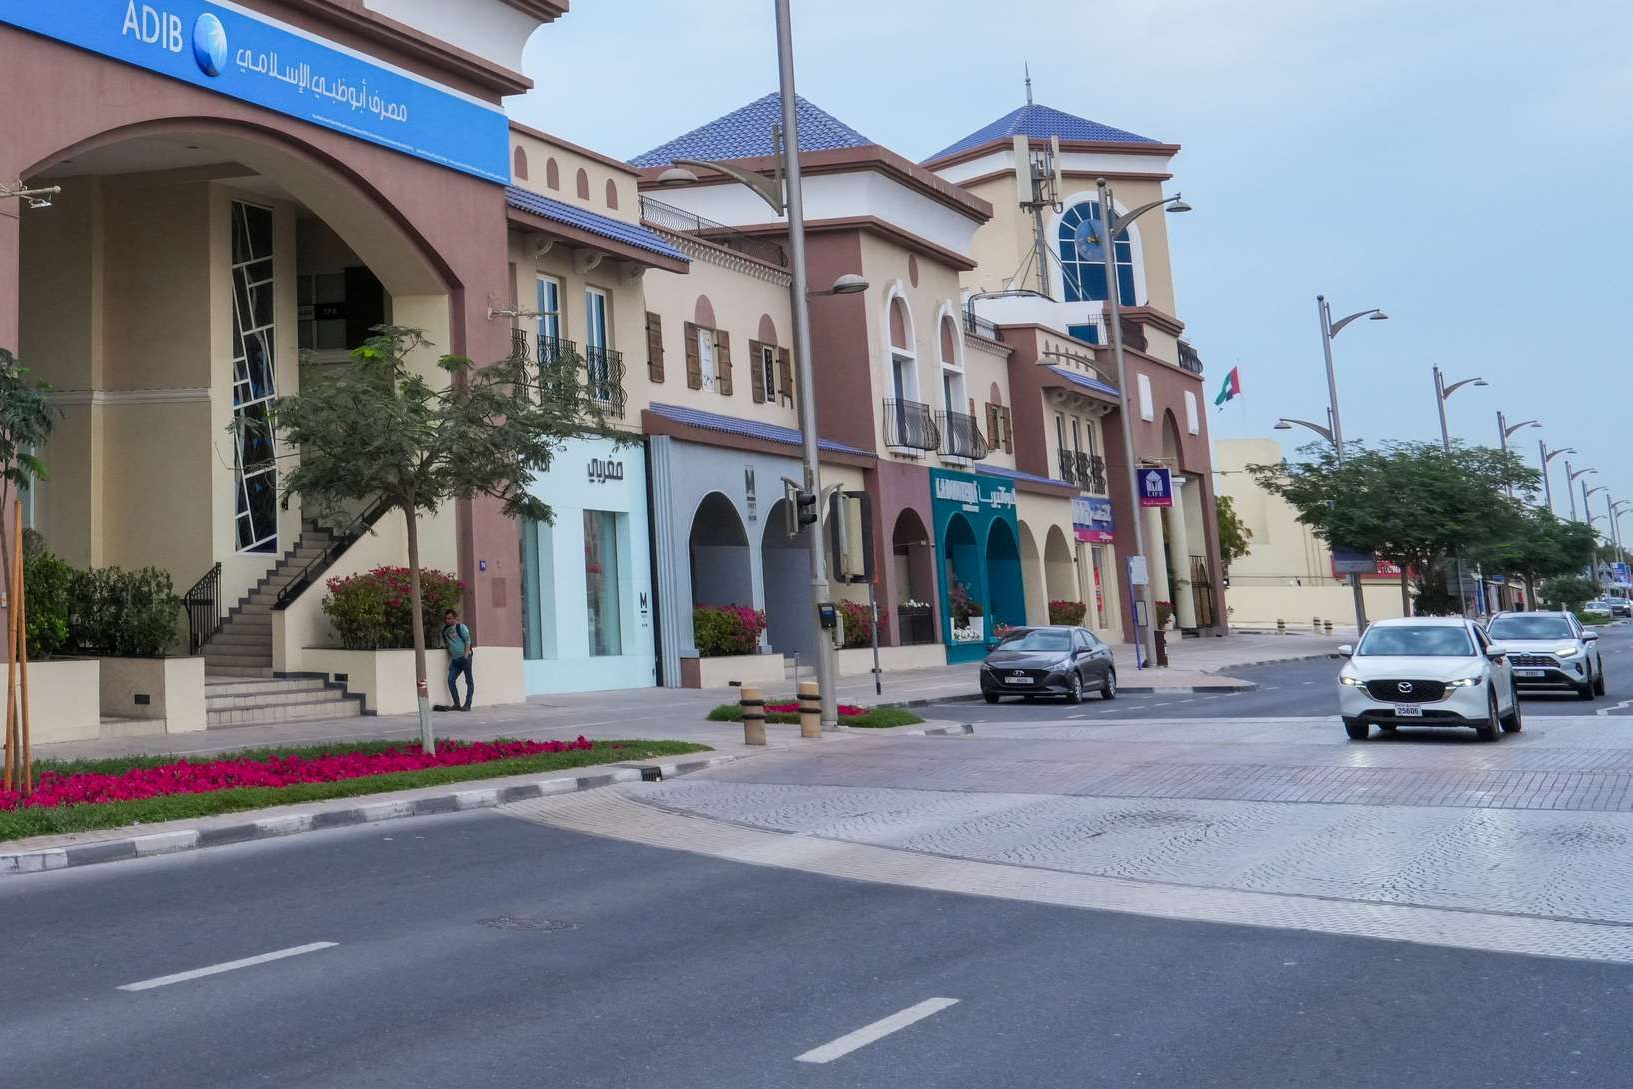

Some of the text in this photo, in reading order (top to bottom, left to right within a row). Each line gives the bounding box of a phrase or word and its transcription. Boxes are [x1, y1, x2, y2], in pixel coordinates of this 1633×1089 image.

[122, 0, 183, 53] ADIB
[235, 48, 310, 94] الإسلامي
[368, 89, 407, 122] مصرف
[587, 454, 624, 484] مغربي
